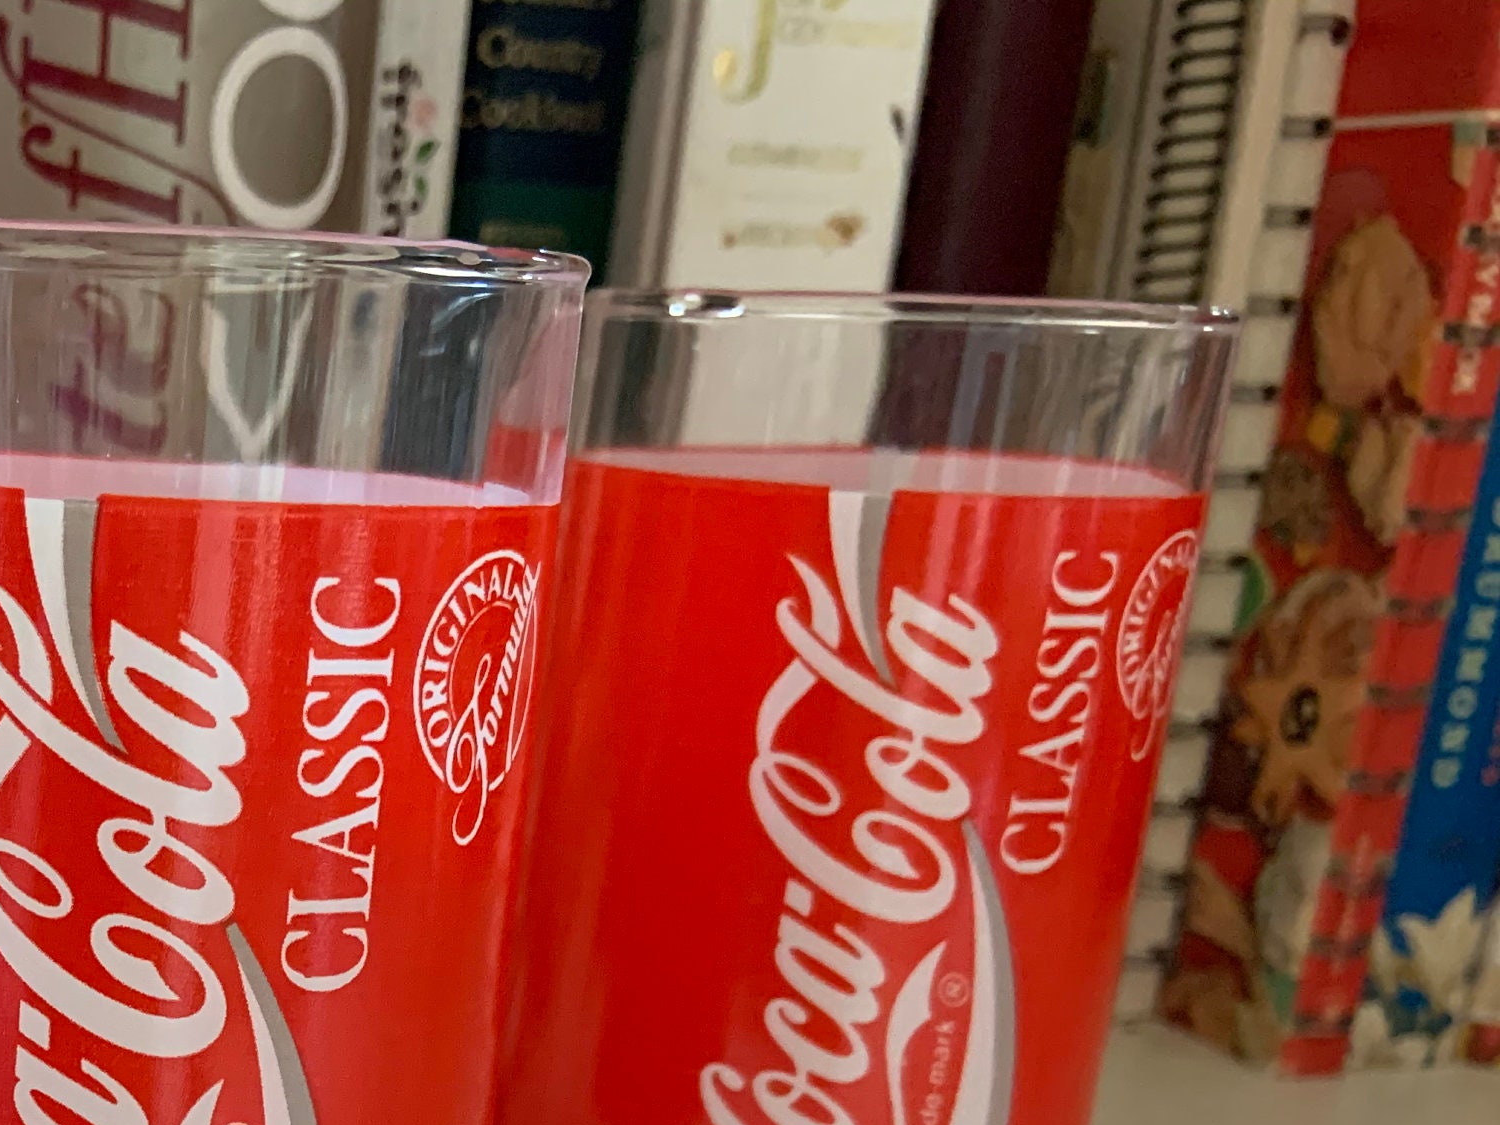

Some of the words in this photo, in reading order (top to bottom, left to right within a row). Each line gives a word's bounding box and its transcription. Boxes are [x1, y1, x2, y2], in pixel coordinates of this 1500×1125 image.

[280, 576, 401, 992] CLASSIC
[421, 563, 520, 749] ORIGINAL
[446, 562, 542, 846] Formula
[1000, 549, 1120, 875] CLASSIC
